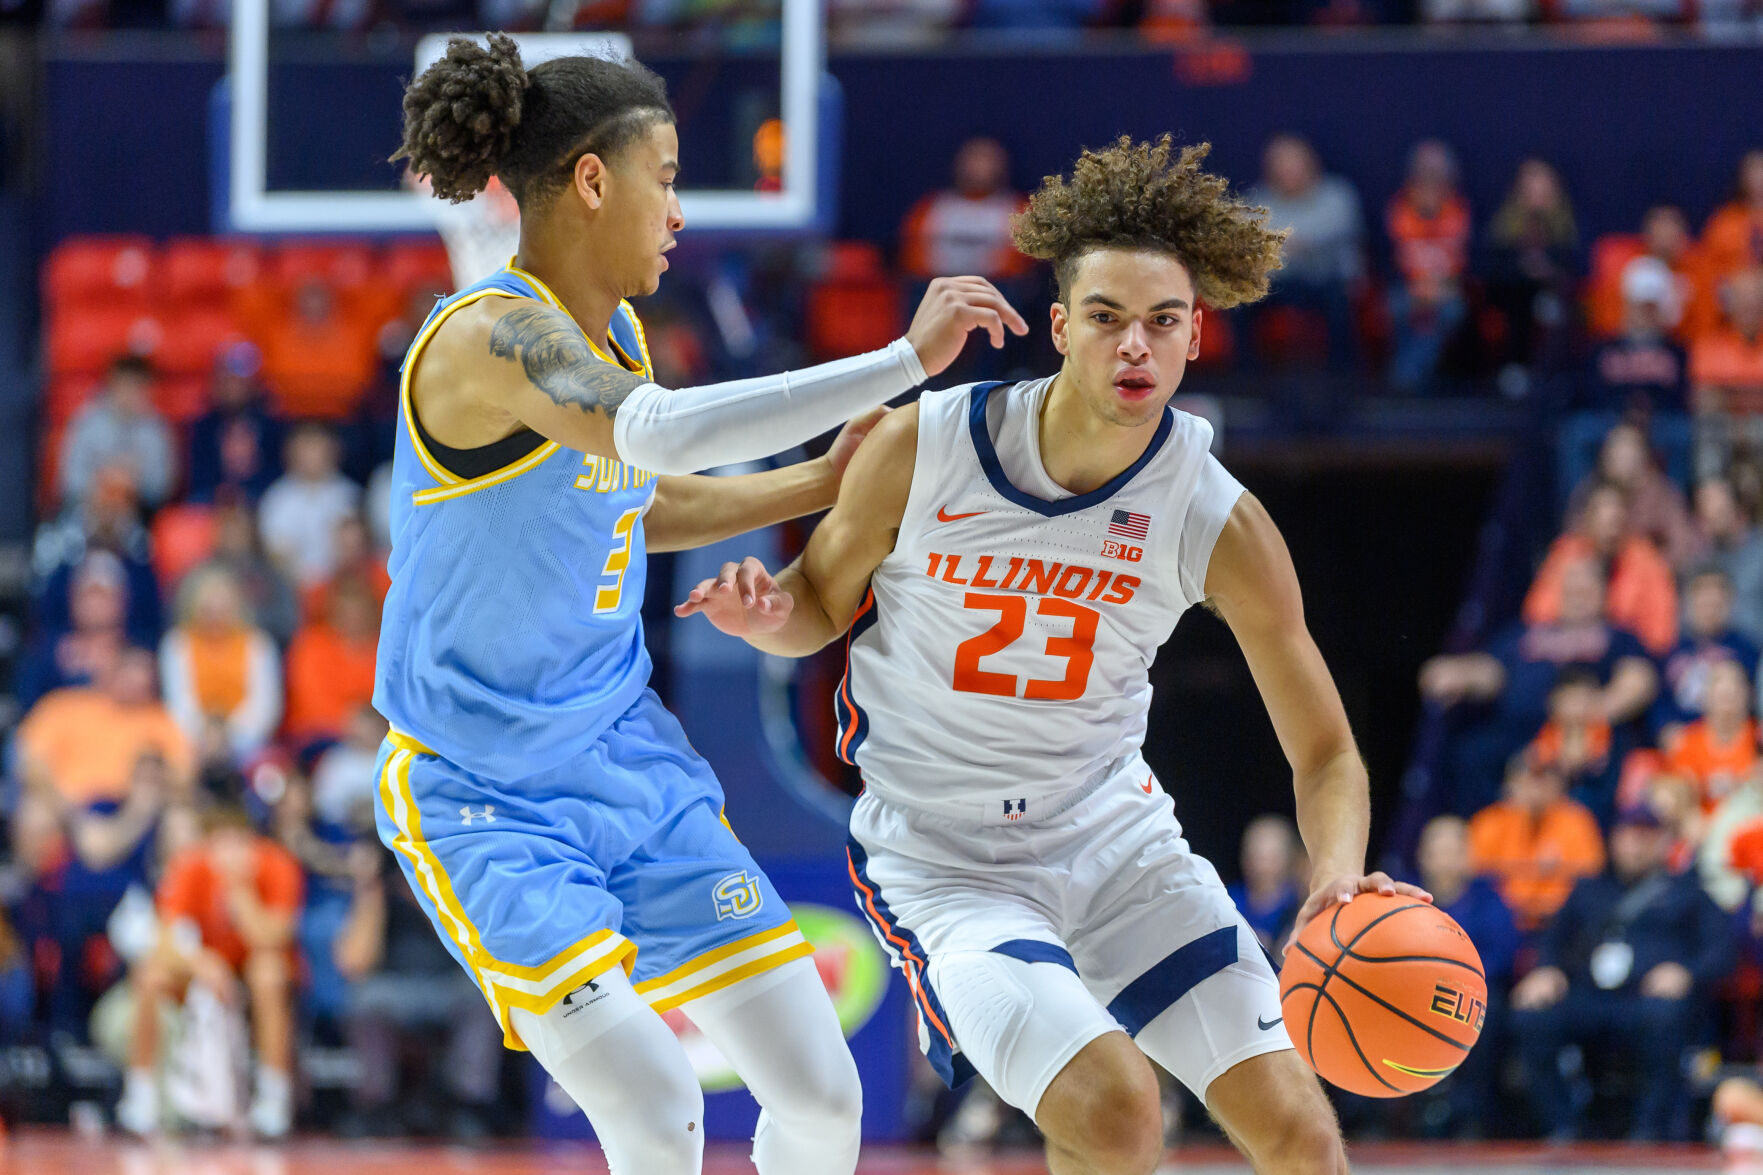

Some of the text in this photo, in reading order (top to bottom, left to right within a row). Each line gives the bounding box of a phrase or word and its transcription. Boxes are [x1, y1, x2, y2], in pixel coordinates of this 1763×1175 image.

[592, 505, 644, 614] 3
[926, 552, 1142, 605] ILLINOIS
[952, 592, 1100, 701] 23
[711, 869, 764, 921] SU
[562, 992, 610, 1018] UNDER ARMOUR
